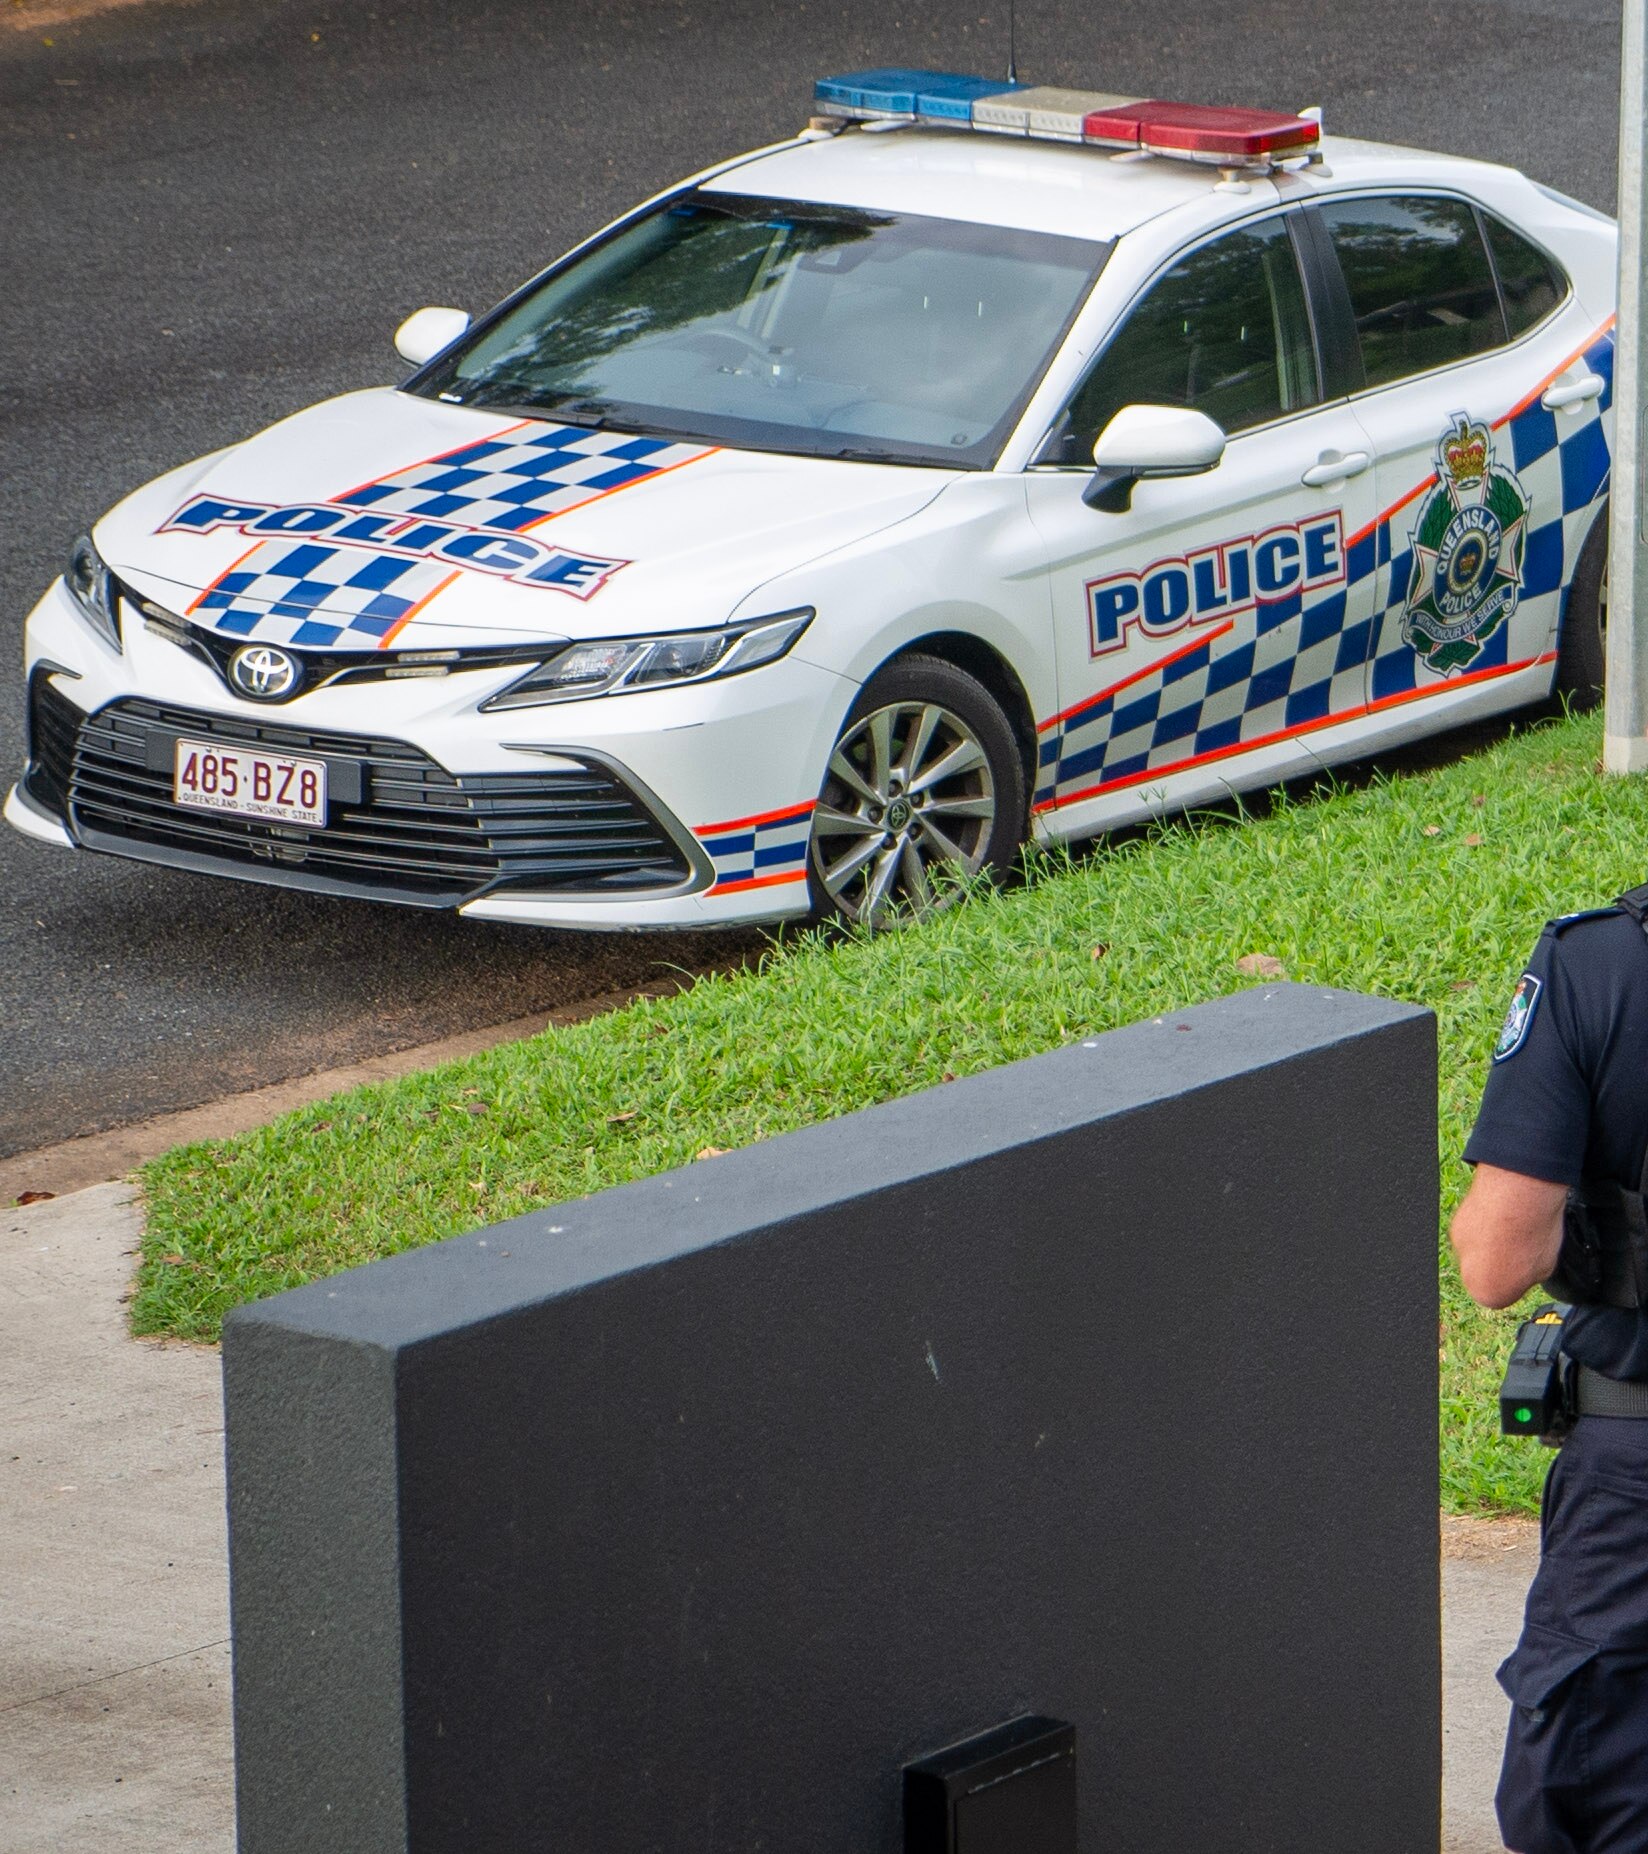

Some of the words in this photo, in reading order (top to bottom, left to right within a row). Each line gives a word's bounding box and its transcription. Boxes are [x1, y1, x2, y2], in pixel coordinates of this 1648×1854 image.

[171, 499, 613, 589] POLICE
[1437, 509, 1501, 575] QUEENSLAND
[1093, 521, 1340, 645] POLICE
[1439, 582, 1482, 614] POLICE
[1462, 617, 1478, 634] WE
[1476, 590, 1504, 622] SERVE
[182, 792, 238, 809] QUEENSLAND
[245, 802, 288, 818] SUNSHINE
[292, 809, 318, 823] STATE
